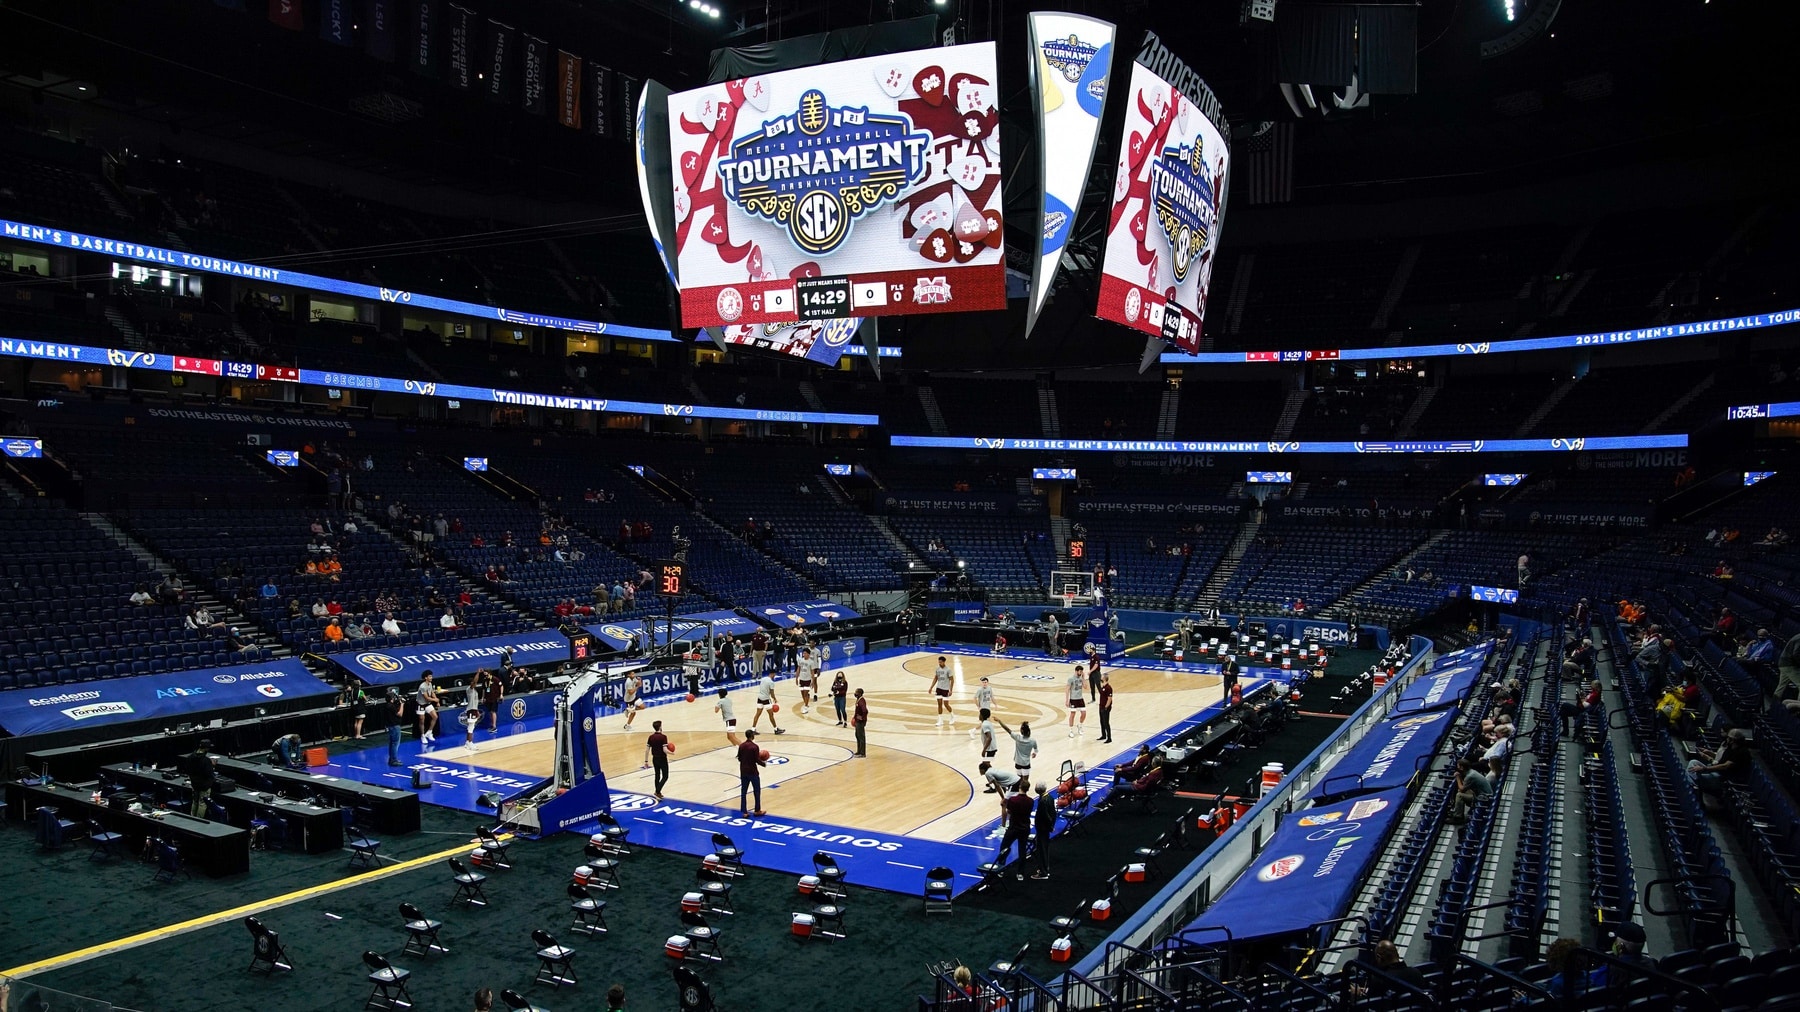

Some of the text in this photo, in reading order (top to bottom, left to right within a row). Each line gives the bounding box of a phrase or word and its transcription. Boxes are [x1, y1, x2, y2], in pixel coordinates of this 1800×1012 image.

[375, 2, 384, 32] LSU
[419, 3, 429, 66] OLE MISS
[452, 27, 461, 70] STATE
[460, 14, 468, 88] MISSISSIPPI
[491, 32, 505, 95] MISSOURI
[525, 43, 536, 107] CAROLINA
[1135, 30, 1223, 130] BRIDGESTONE
[565, 57, 574, 126] TENNESSEE
[597, 70, 605, 135] TEXAS A&M
[798, 129, 892, 148] BASKETBALL
[719, 138, 929, 190] TOURNAMENT
[781, 175, 856, 192] NASHVILLE
[1153, 164, 1215, 226] TOURNAMENT
[800, 195, 838, 240] SEC
[5, 222, 281, 281] MEN'S BASKETBALL TOURNAMENT
[775, 296, 782, 305] 0
[802, 289, 847, 306] 14:29
[867, 289, 874, 299] 0
[893, 291, 902, 302] 0
[821, 308, 836, 316] HALF
[1576, 334, 1605, 345] 2021
[1610, 332, 1632, 342] SEC
[1637, 326, 1673, 340] MEN'S
[1679, 316, 1762, 335] BASKETBALL
[1284, 351, 1302, 359] 14:29
[213, 361, 220, 372] 0
[228, 362, 253, 373] 14:29
[259, 366, 265, 376] 0
[496, 391, 602, 411] TOURNAMENT
[148, 408, 352, 429] SOUTHEASTERN CONFERENCE
[1014, 440, 1260, 451] 2021 SEC MEN'S BASKETBALL TOURNAMENT
[1168, 454, 1216, 468] MORE
[1636, 451, 1688, 468] MORE
[1078, 502, 1165, 513] SOUTHEASTERN
[1071, 547, 1082, 557] 30
[664, 565, 682, 576] 14:29
[663, 576, 679, 593] 30
[574, 637, 588, 647] 14:29
[361, 640, 566, 671] SEC IT JUST MEANS MORE.
[576, 646, 586, 658] 30
[28, 690, 101, 705] Academy
[513, 700, 525, 717] SEC
[653, 805, 903, 852] SOUTHEASTERN
